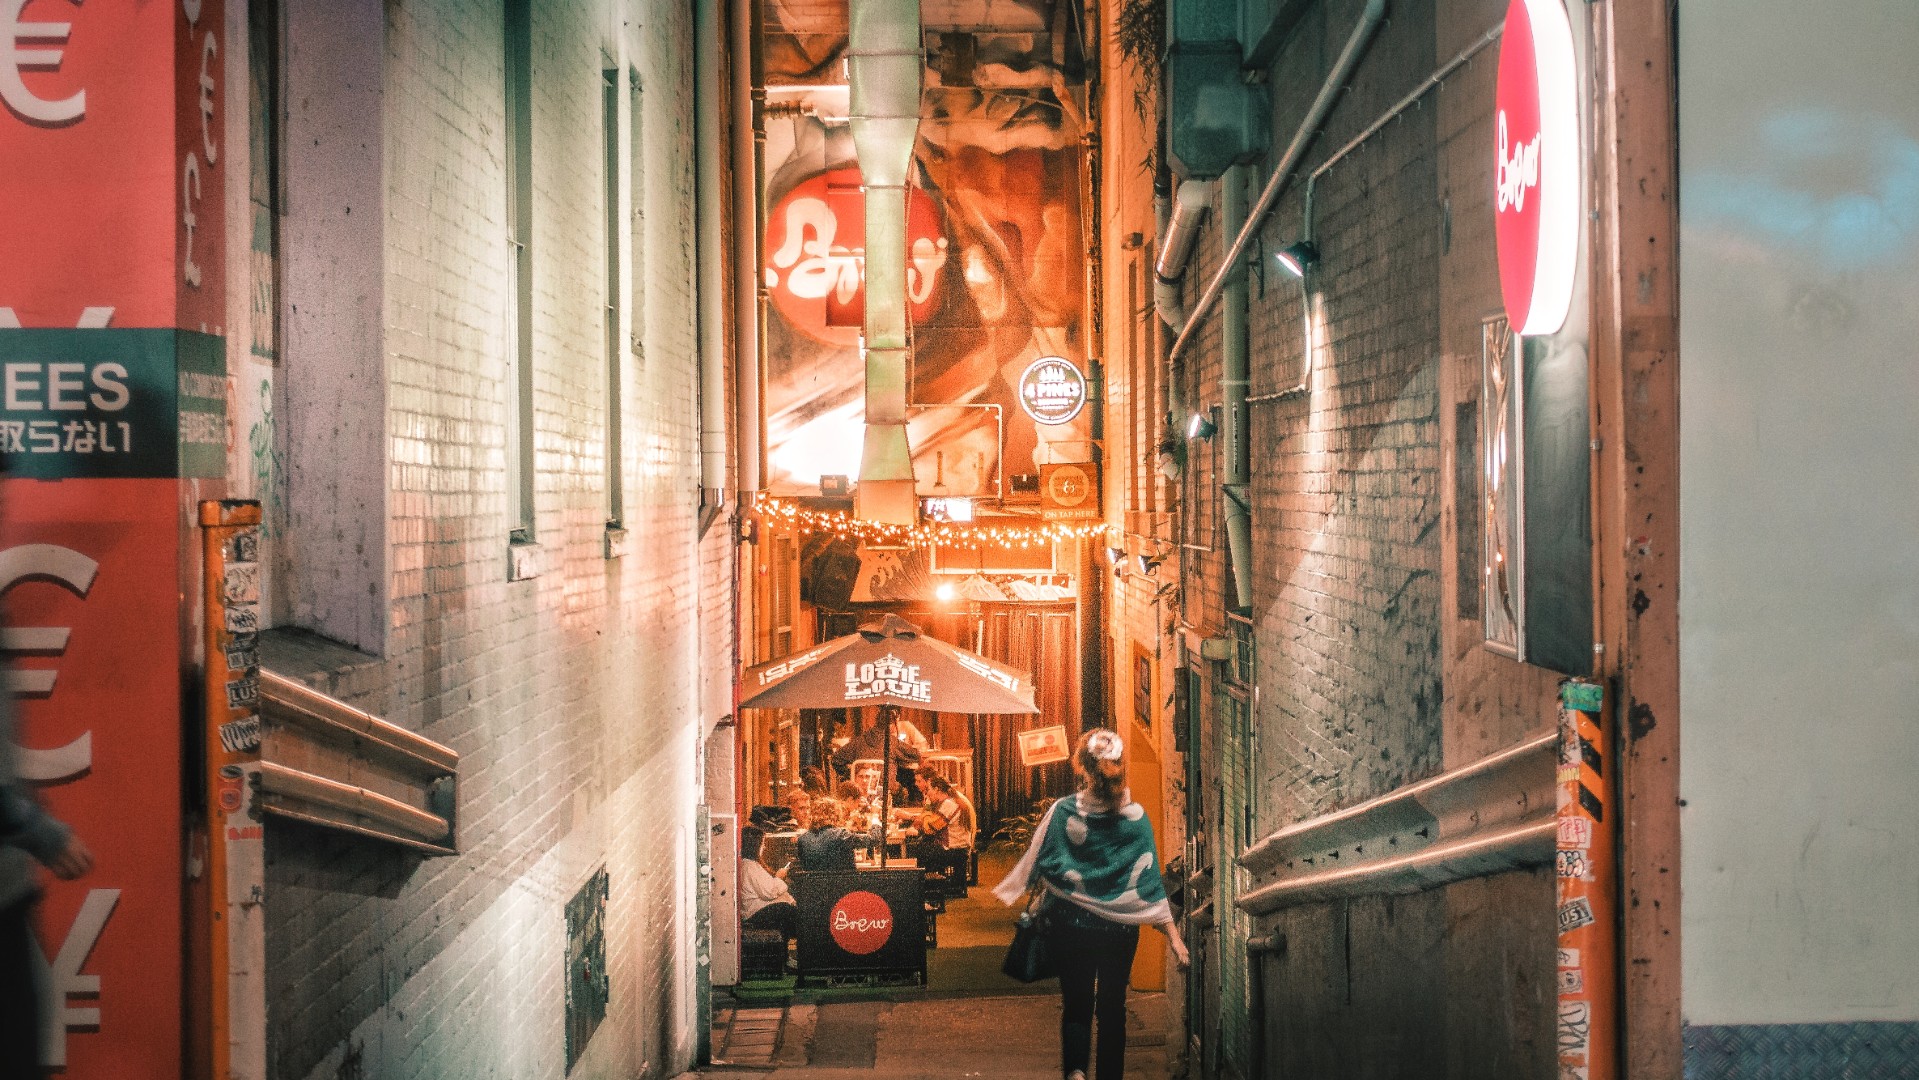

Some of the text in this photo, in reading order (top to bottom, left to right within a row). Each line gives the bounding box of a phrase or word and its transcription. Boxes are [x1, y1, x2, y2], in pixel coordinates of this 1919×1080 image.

[1498, 109, 1541, 213] Brew
[5, 362, 130, 411] EES
[1045, 511, 1057, 519] ON
[1076, 510, 1096, 518] HERE
[833, 910, 890, 932] Brew
